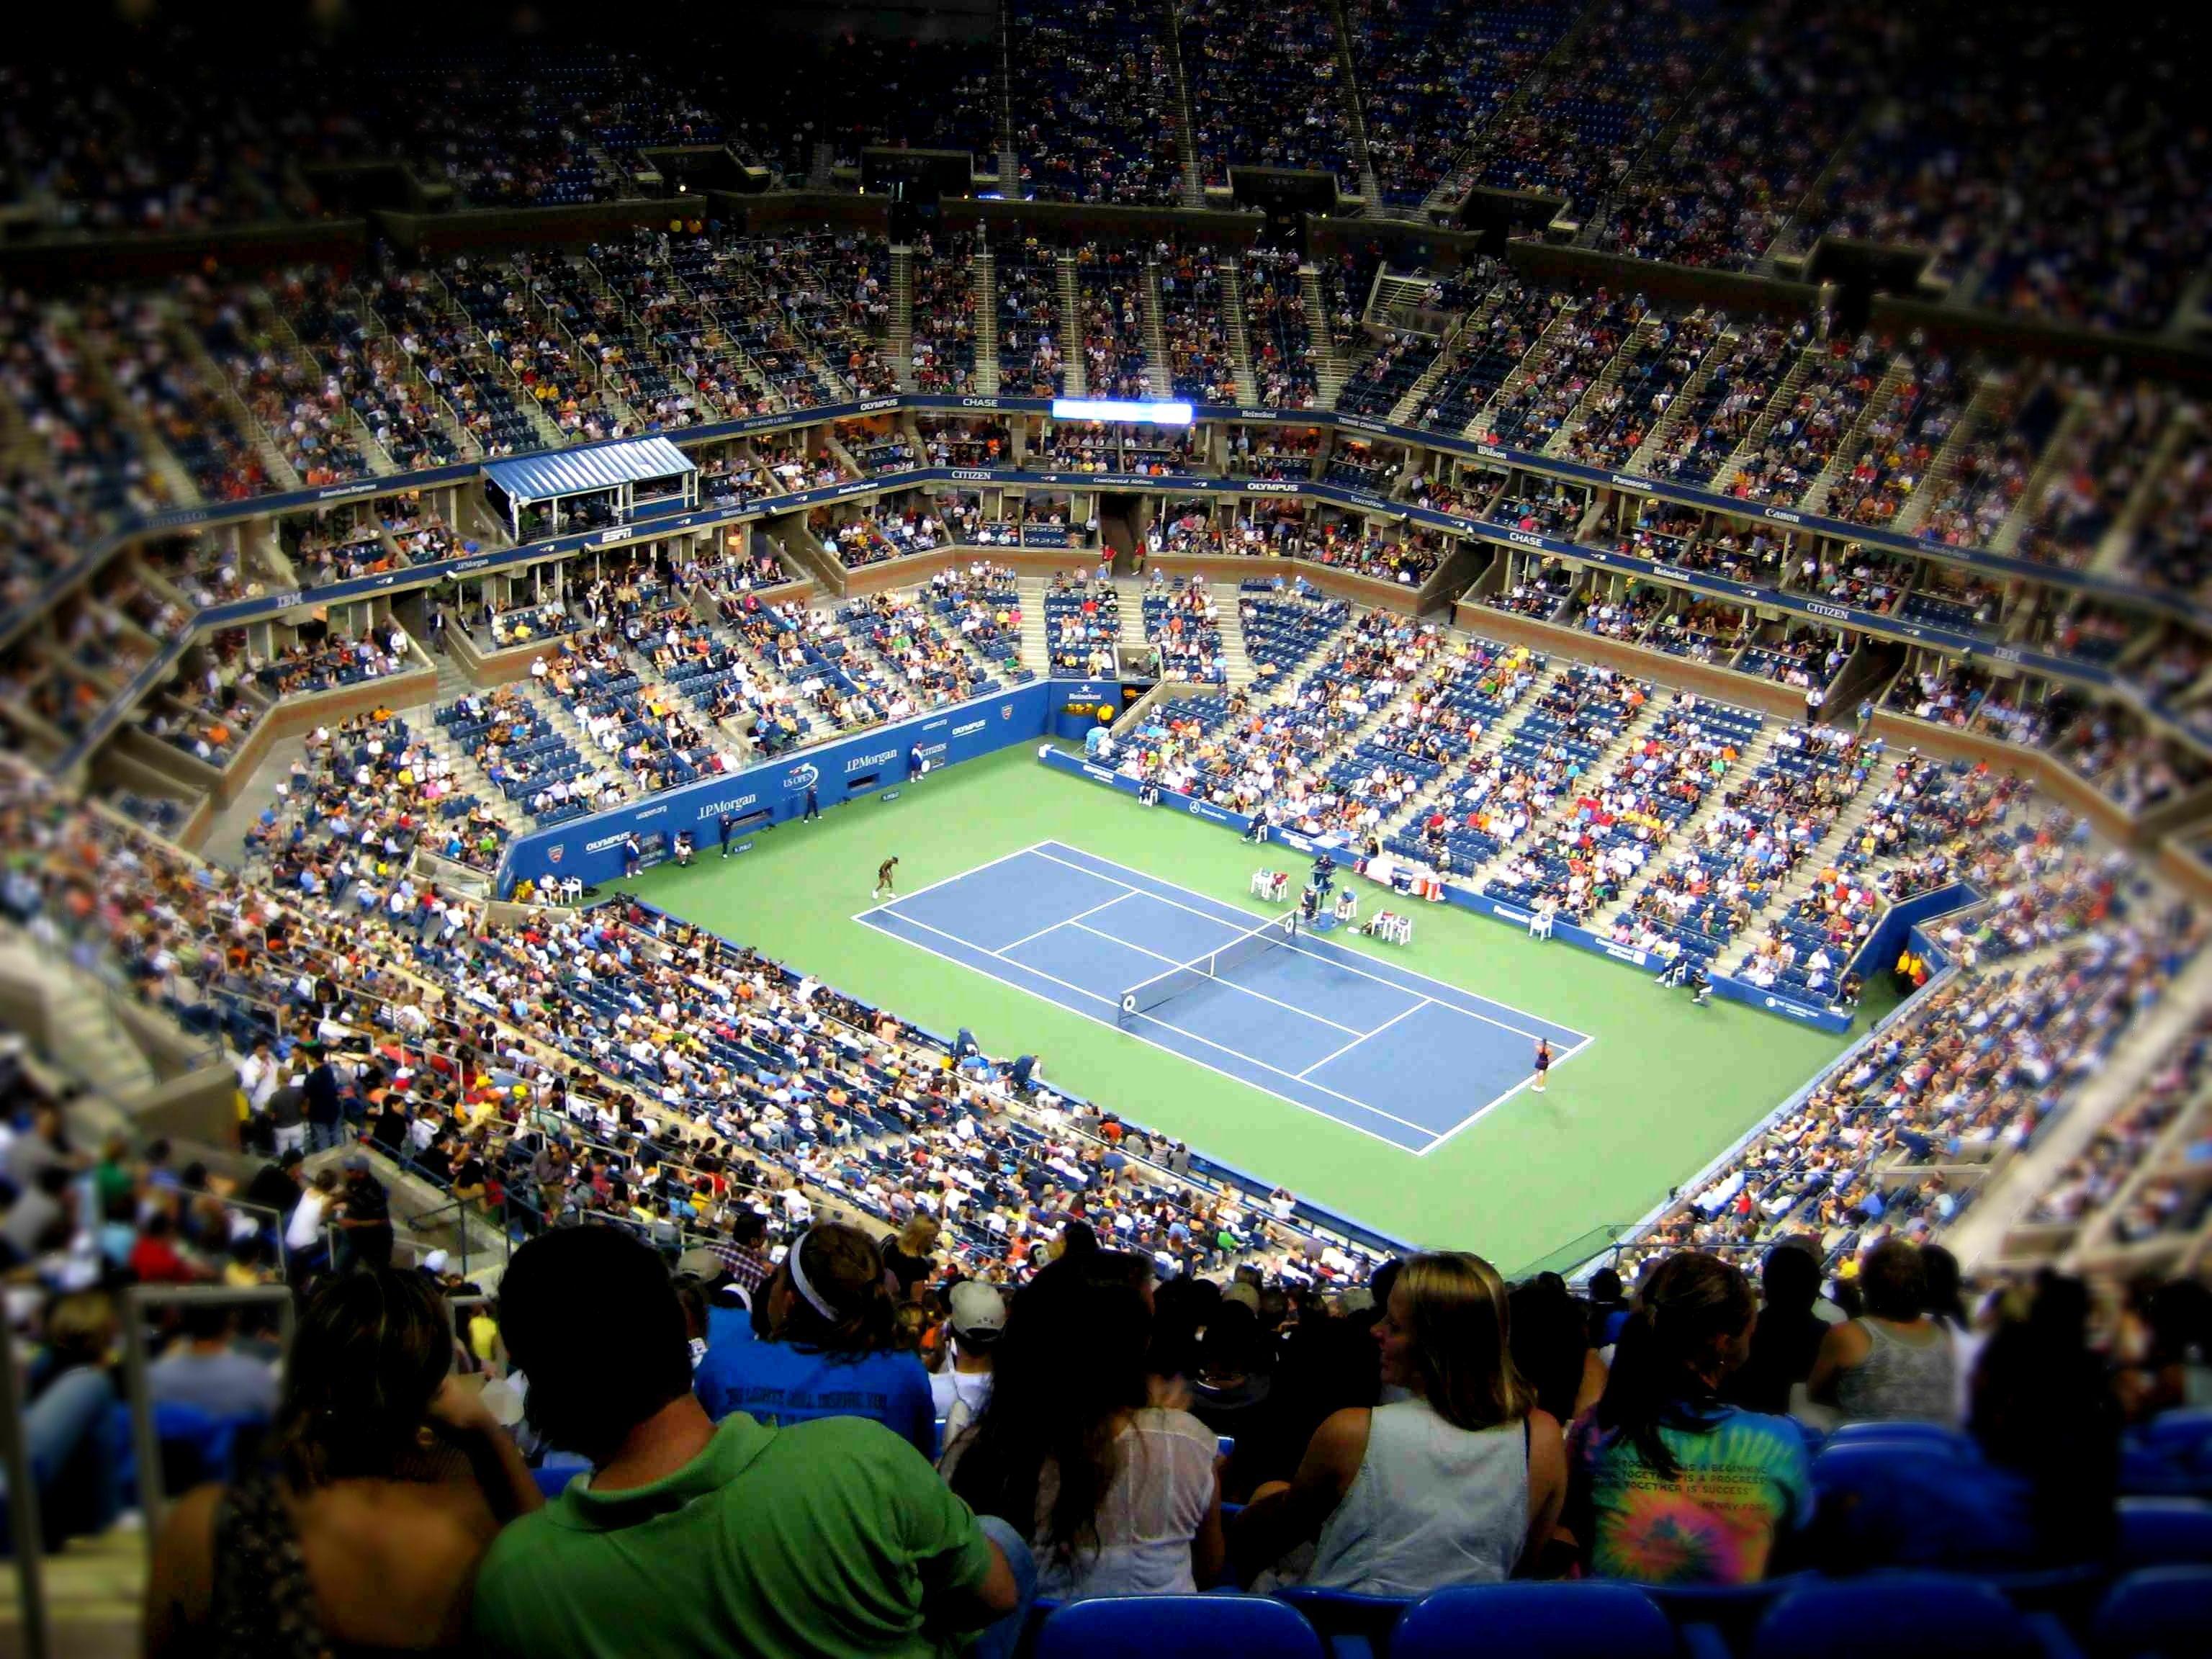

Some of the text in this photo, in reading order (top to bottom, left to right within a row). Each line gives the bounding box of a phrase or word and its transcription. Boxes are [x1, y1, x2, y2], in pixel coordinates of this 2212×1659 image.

[860, 398, 899, 411] OLYMPUS
[962, 397, 999, 408] CHASE
[1477, 445, 1507, 459] Wilson
[951, 470, 992, 480] CITIZEN
[1612, 475, 1653, 490] Panasonic
[1246, 482, 1299, 491] OLYMPUS
[1764, 508, 1800, 523] Canon
[601, 528, 632, 544] ESPN
[1509, 532, 1543, 547] CHASE
[276, 592, 303, 608] IBM
[1806, 603, 1850, 620] CITIZEN
[1993, 647, 2022, 662] IBM
[952, 720, 986, 735] OLYMPUS
[783, 778, 793, 788] US
[585, 831, 631, 851] OLYMPUS
